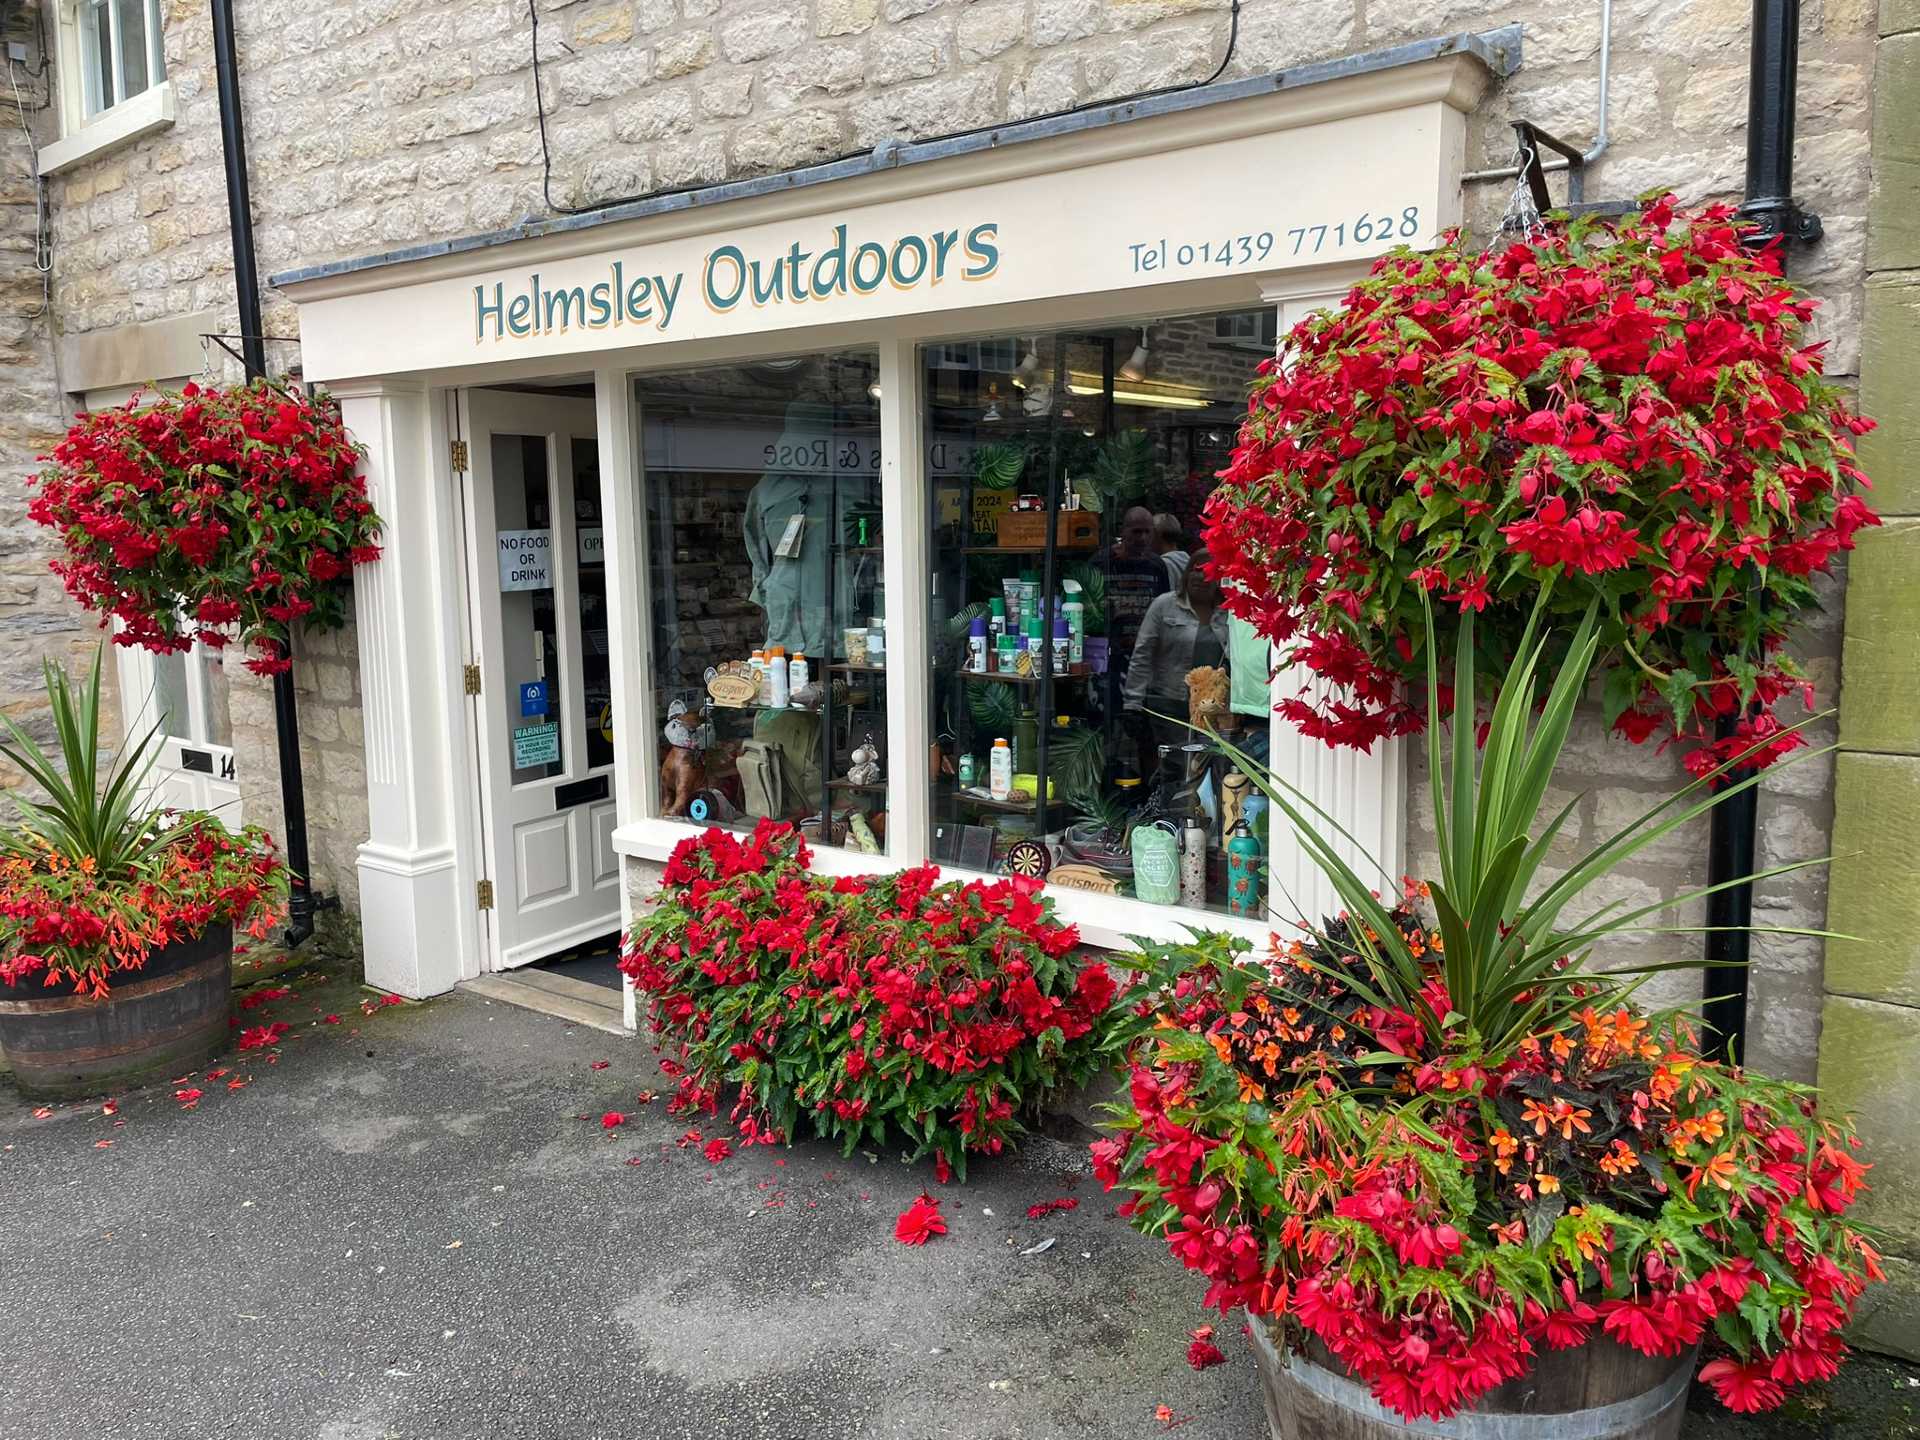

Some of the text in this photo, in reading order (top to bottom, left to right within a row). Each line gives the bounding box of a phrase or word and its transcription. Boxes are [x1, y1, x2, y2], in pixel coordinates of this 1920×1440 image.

[1129, 206, 1419, 273] Tel 01439 771628
[473, 223, 999, 344] Helmsley Outdoors
[500, 536, 549, 550] NO FOOD
[520, 553, 535, 565] OR
[511, 568, 546, 582] DRINK
[515, 723, 557, 738] WARNING!
[220, 754, 235, 779] 14
